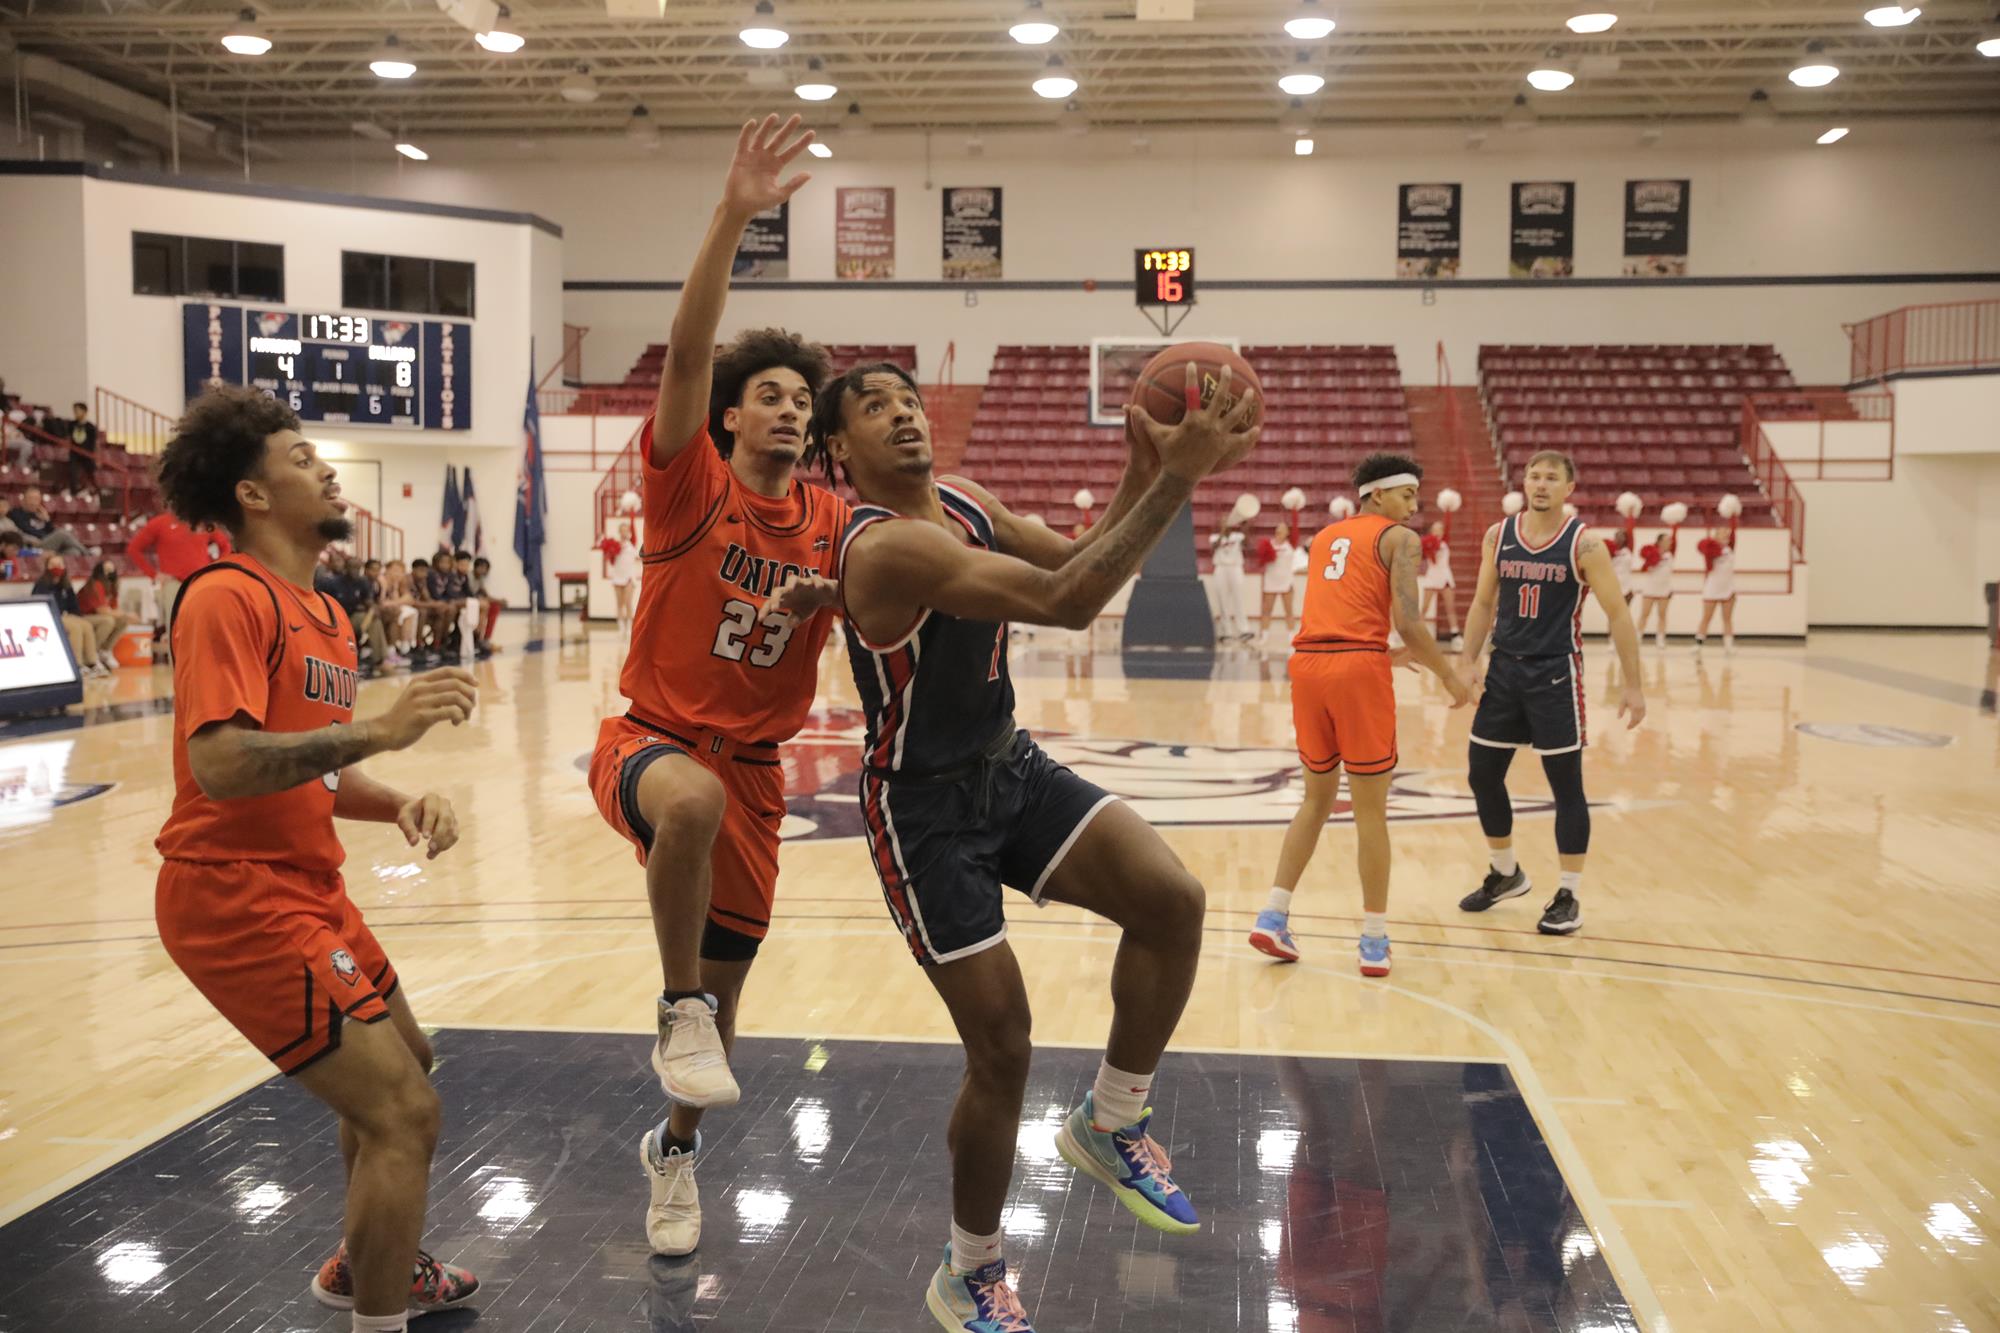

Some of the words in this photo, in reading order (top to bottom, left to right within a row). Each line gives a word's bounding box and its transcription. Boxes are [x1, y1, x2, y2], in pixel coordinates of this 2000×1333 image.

[1144, 251, 1190, 271] 17:33
[1157, 270, 1183, 302] 16
[310, 315, 368, 343] 17:33
[278, 356, 295, 379] 4
[335, 362, 342, 380] 1
[396, 362, 412, 387] 8
[441, 322, 454, 430] PATRIOTS
[289, 391, 302, 411] 6
[369, 395, 382, 415] 6
[1323, 537, 1351, 580] 3
[1500, 560, 1567, 583] PATRIOTS
[1518, 583, 1540, 618] 11
[711, 598, 795, 669] 23
